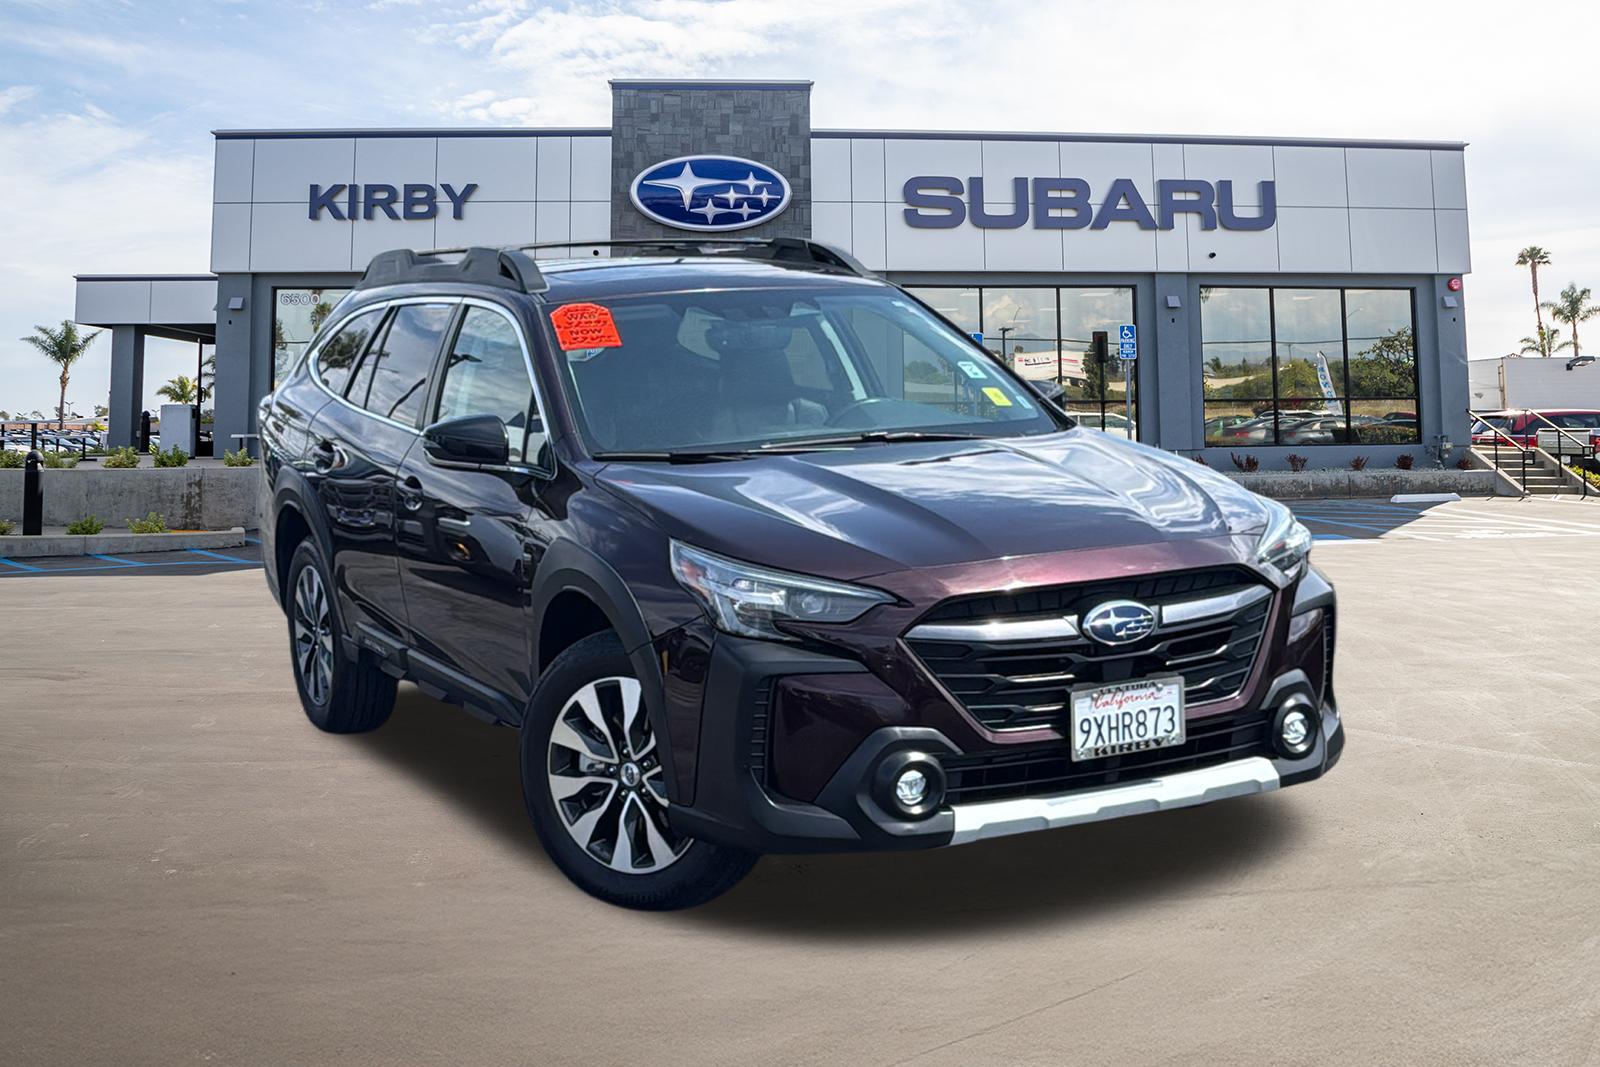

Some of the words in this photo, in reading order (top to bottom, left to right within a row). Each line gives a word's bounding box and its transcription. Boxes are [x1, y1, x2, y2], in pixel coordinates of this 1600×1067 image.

[308, 183, 479, 221] KIRBY
[903, 176, 1277, 230] SUBARU
[280, 293, 320, 306] 6500
[569, 328, 602, 336] NOW
[1092, 691, 1160, 709] California
[1080, 705, 1175, 748] 9XHR873
[1093, 738, 1166, 757] KIRBY
